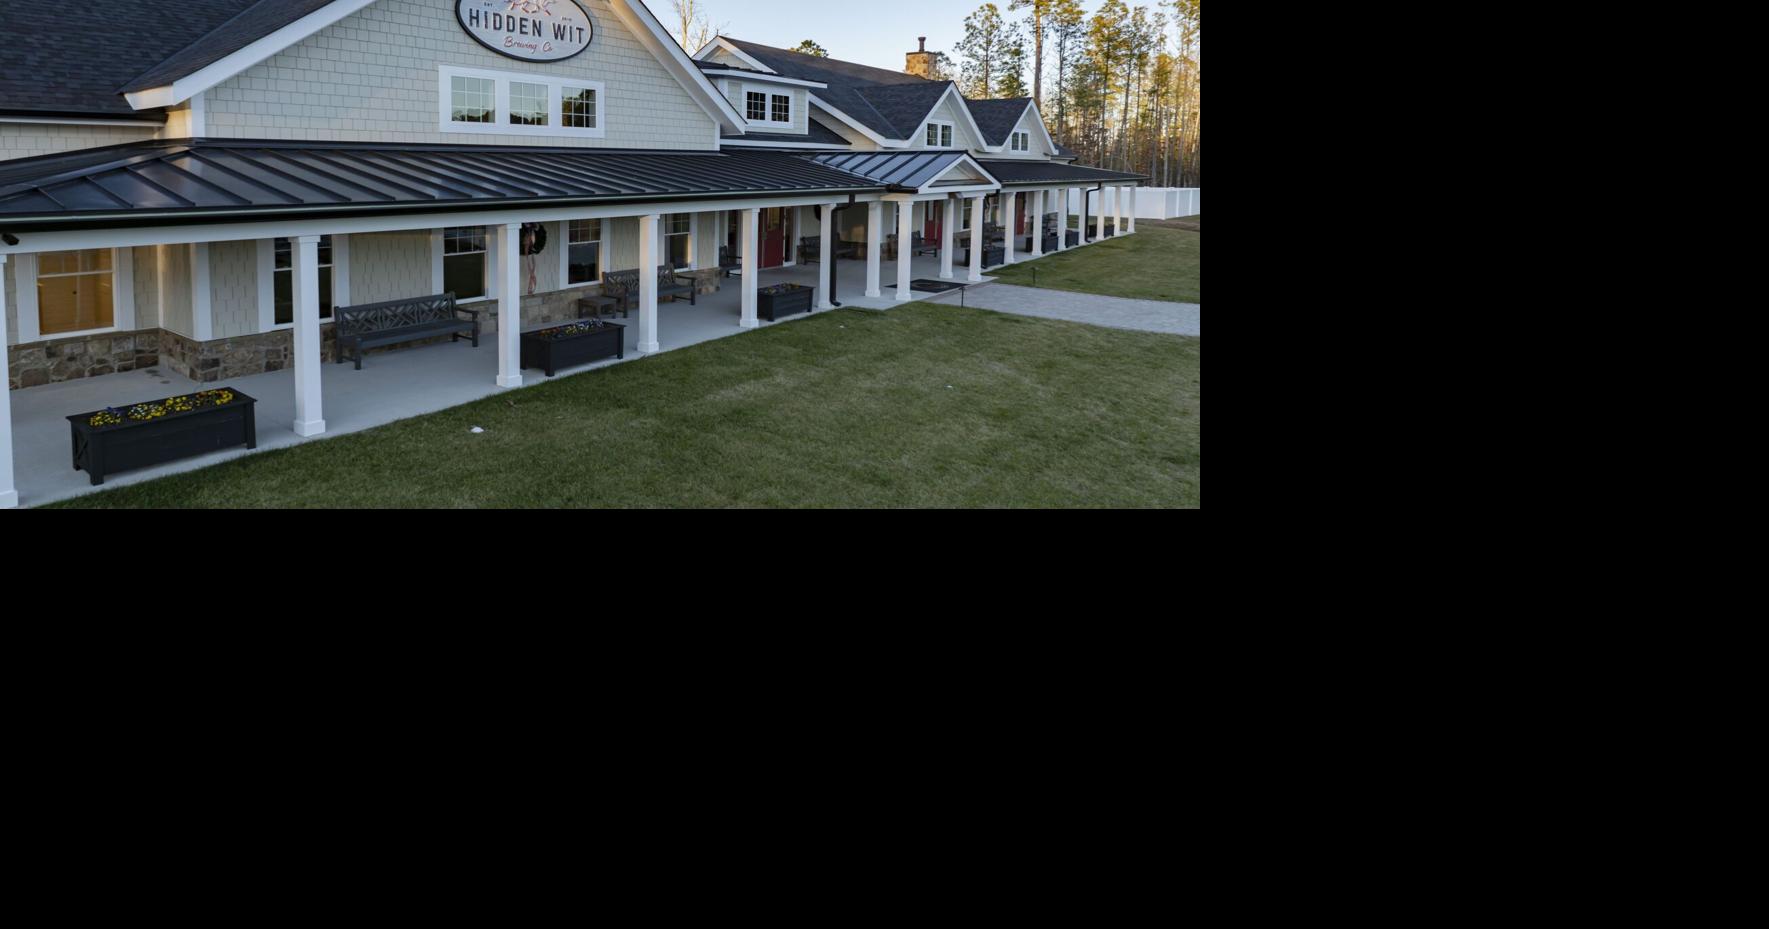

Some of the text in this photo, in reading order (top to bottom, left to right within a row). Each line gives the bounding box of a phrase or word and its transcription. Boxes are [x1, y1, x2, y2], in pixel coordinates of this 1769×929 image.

[469, 8, 584, 44] HIDDEN WIT
[504, 36, 537, 54] Brewing
